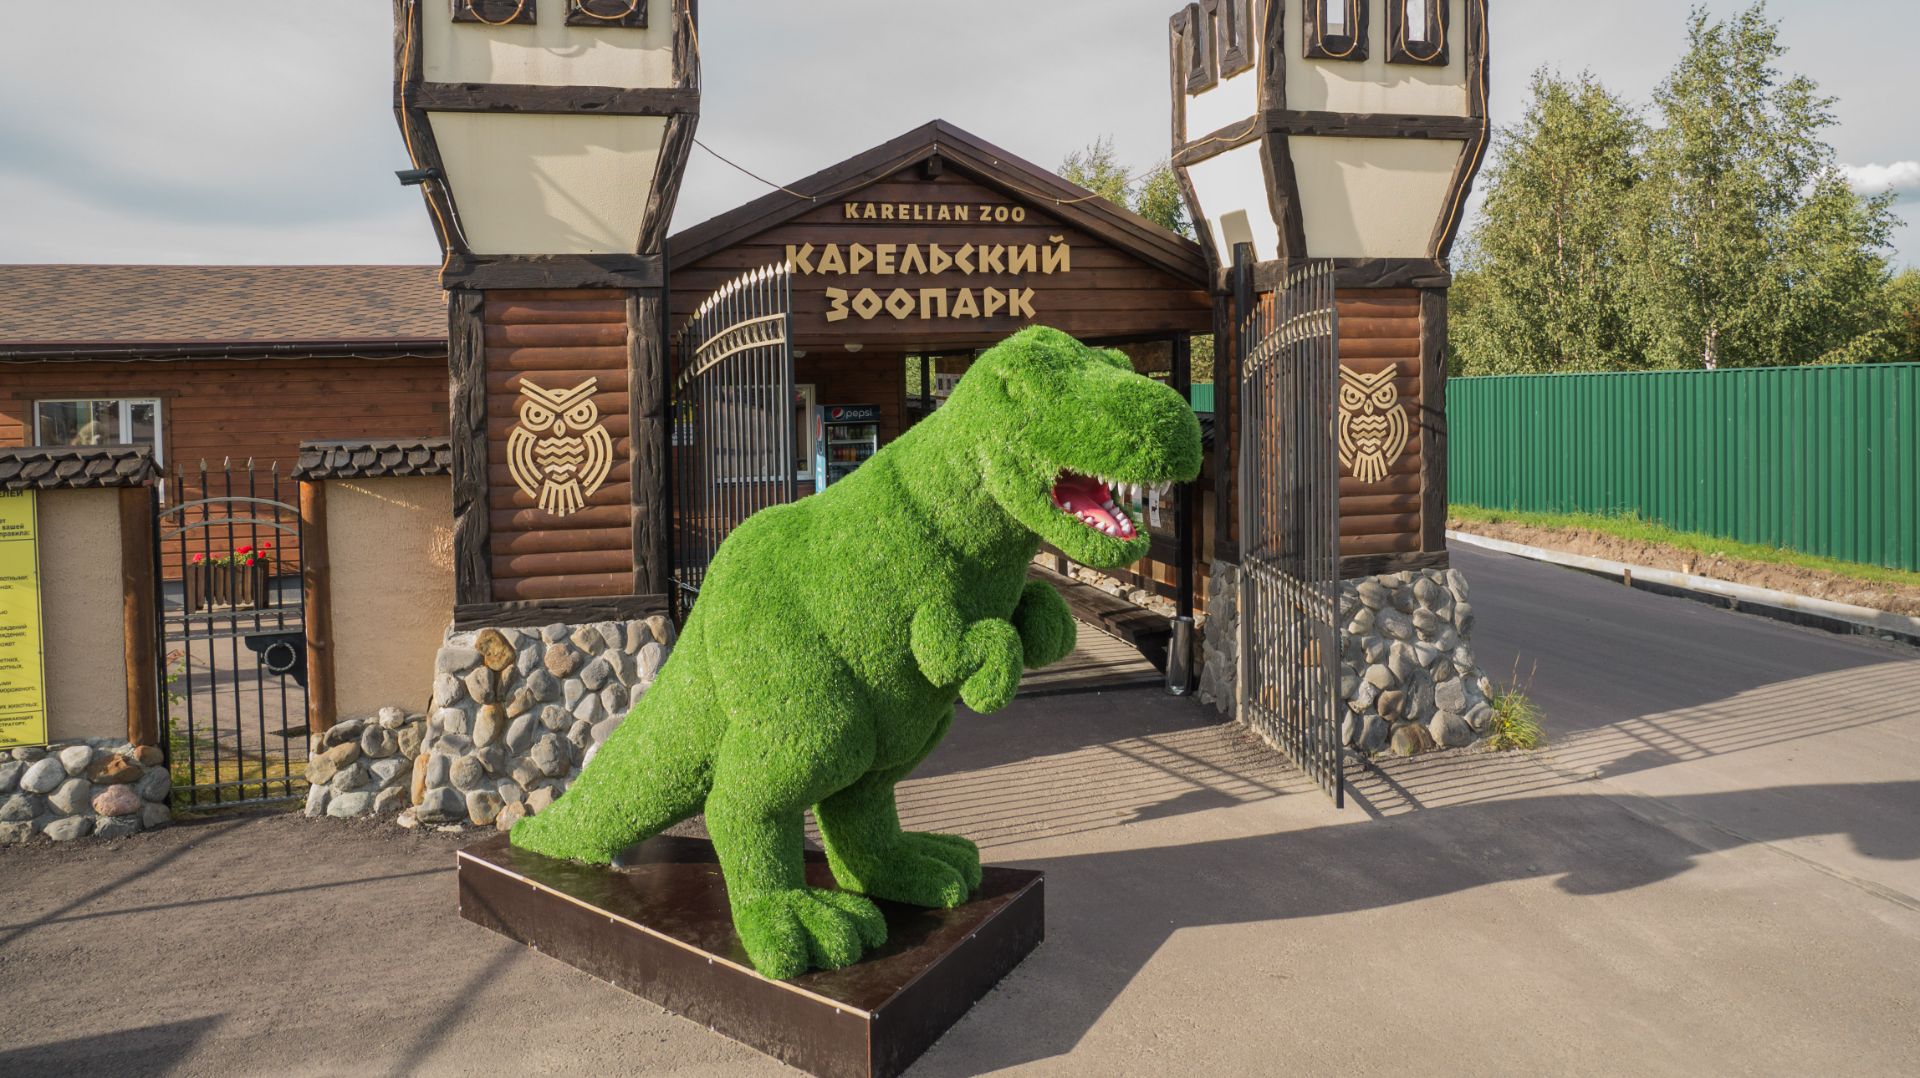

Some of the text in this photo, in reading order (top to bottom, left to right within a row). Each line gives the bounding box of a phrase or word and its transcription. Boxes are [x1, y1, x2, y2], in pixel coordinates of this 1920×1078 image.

[845, 202, 1026, 222] KARELIAN ZOO
[785, 234, 1071, 275] КАРЕЛЬСКИЙ
[825, 286, 1036, 322] ЗООПАРК
[846, 408, 873, 419] pepsi
